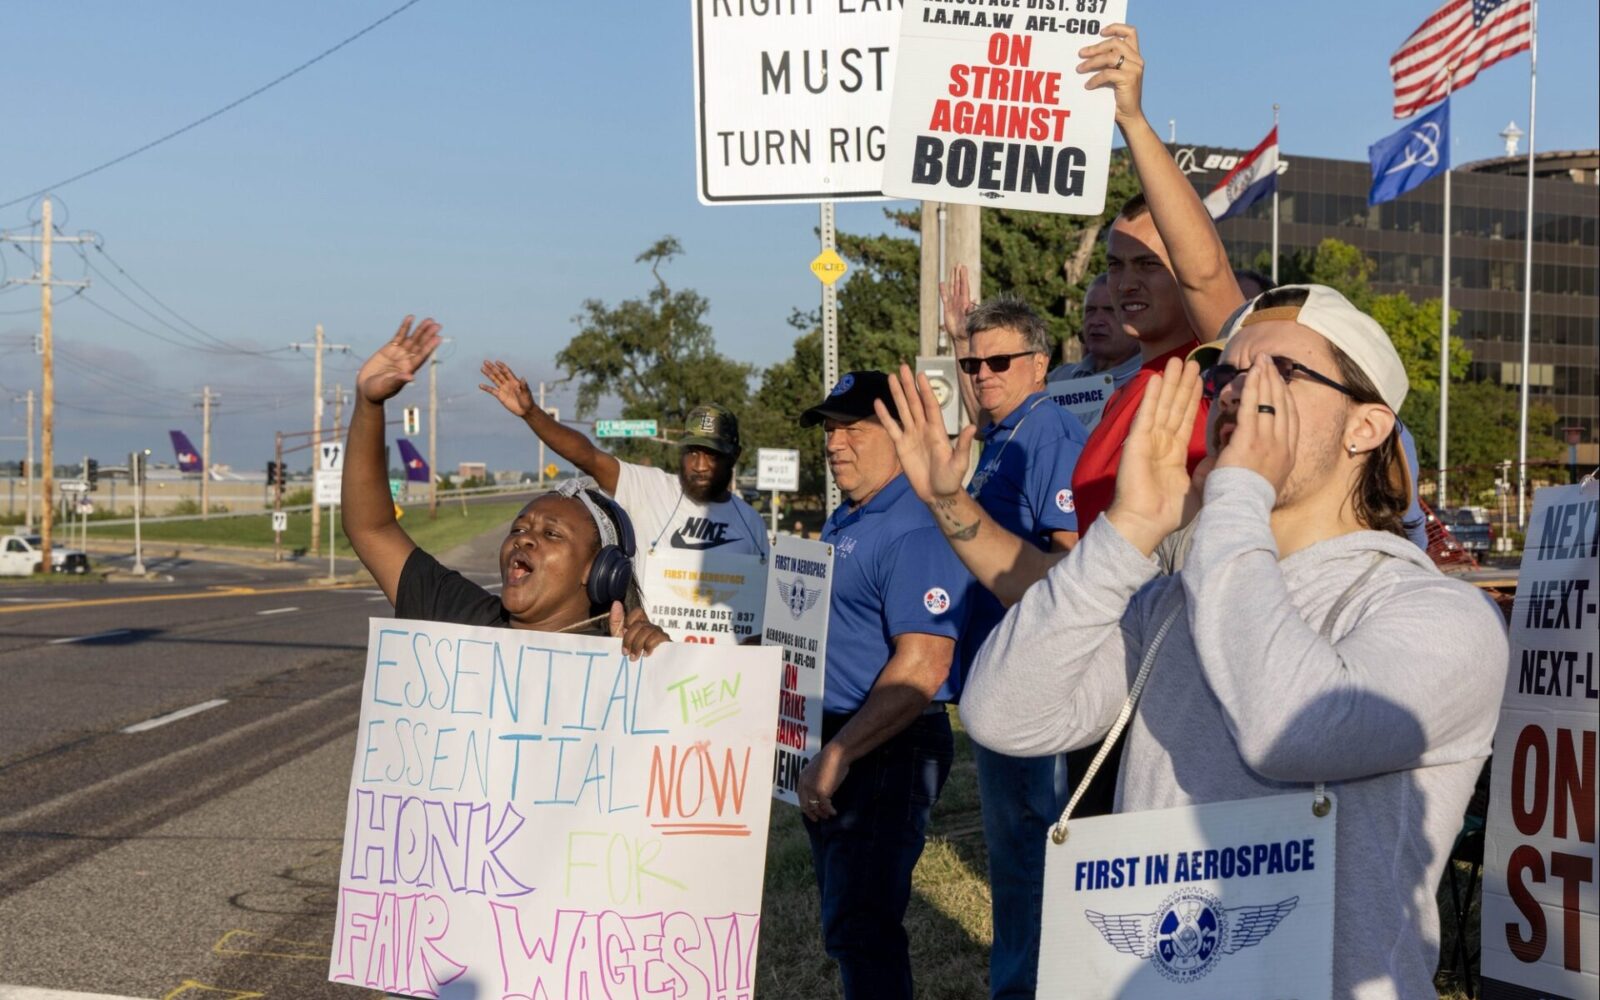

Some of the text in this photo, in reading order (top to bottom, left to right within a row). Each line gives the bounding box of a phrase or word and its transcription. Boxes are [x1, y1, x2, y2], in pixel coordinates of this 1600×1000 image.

[1025, 15, 1101, 36] AFL-CIO
[987, 32, 1032, 68] ON
[761, 46, 890, 95] MUST
[949, 64, 1062, 105] STRIKE
[929, 99, 1071, 143] AGAINST
[717, 128, 811, 167] TURN
[911, 135, 1087, 197] BOEING
[1049, 389, 1104, 406] EROSPACE
[682, 516, 729, 541] NIKE
[664, 569, 687, 580] FIRST
[775, 554, 827, 579] FIRST IN AEROSPACE
[652, 605, 755, 622] AEROSPACE DIST. 837
[1526, 579, 1599, 630] NEXT-
[711, 623, 752, 635] AFL-CIO
[766, 628, 793, 646] AEROSPACE
[808, 639, 818, 653] 837
[784, 663, 798, 691] ON
[794, 651, 816, 669] AFL-CIO
[374, 629, 669, 735] ESSENTIAL
[776, 718, 808, 751] AINST
[362, 718, 751, 819] ESSENTIAL NOW
[772, 748, 809, 793] EIN
[1511, 724, 1597, 843] ON
[350, 788, 688, 905] HONK FOR
[1075, 838, 1315, 892] FIRST IN AEROSPACE
[1505, 844, 1593, 973] ST
[335, 888, 760, 1000] FAIR WAGES!!
